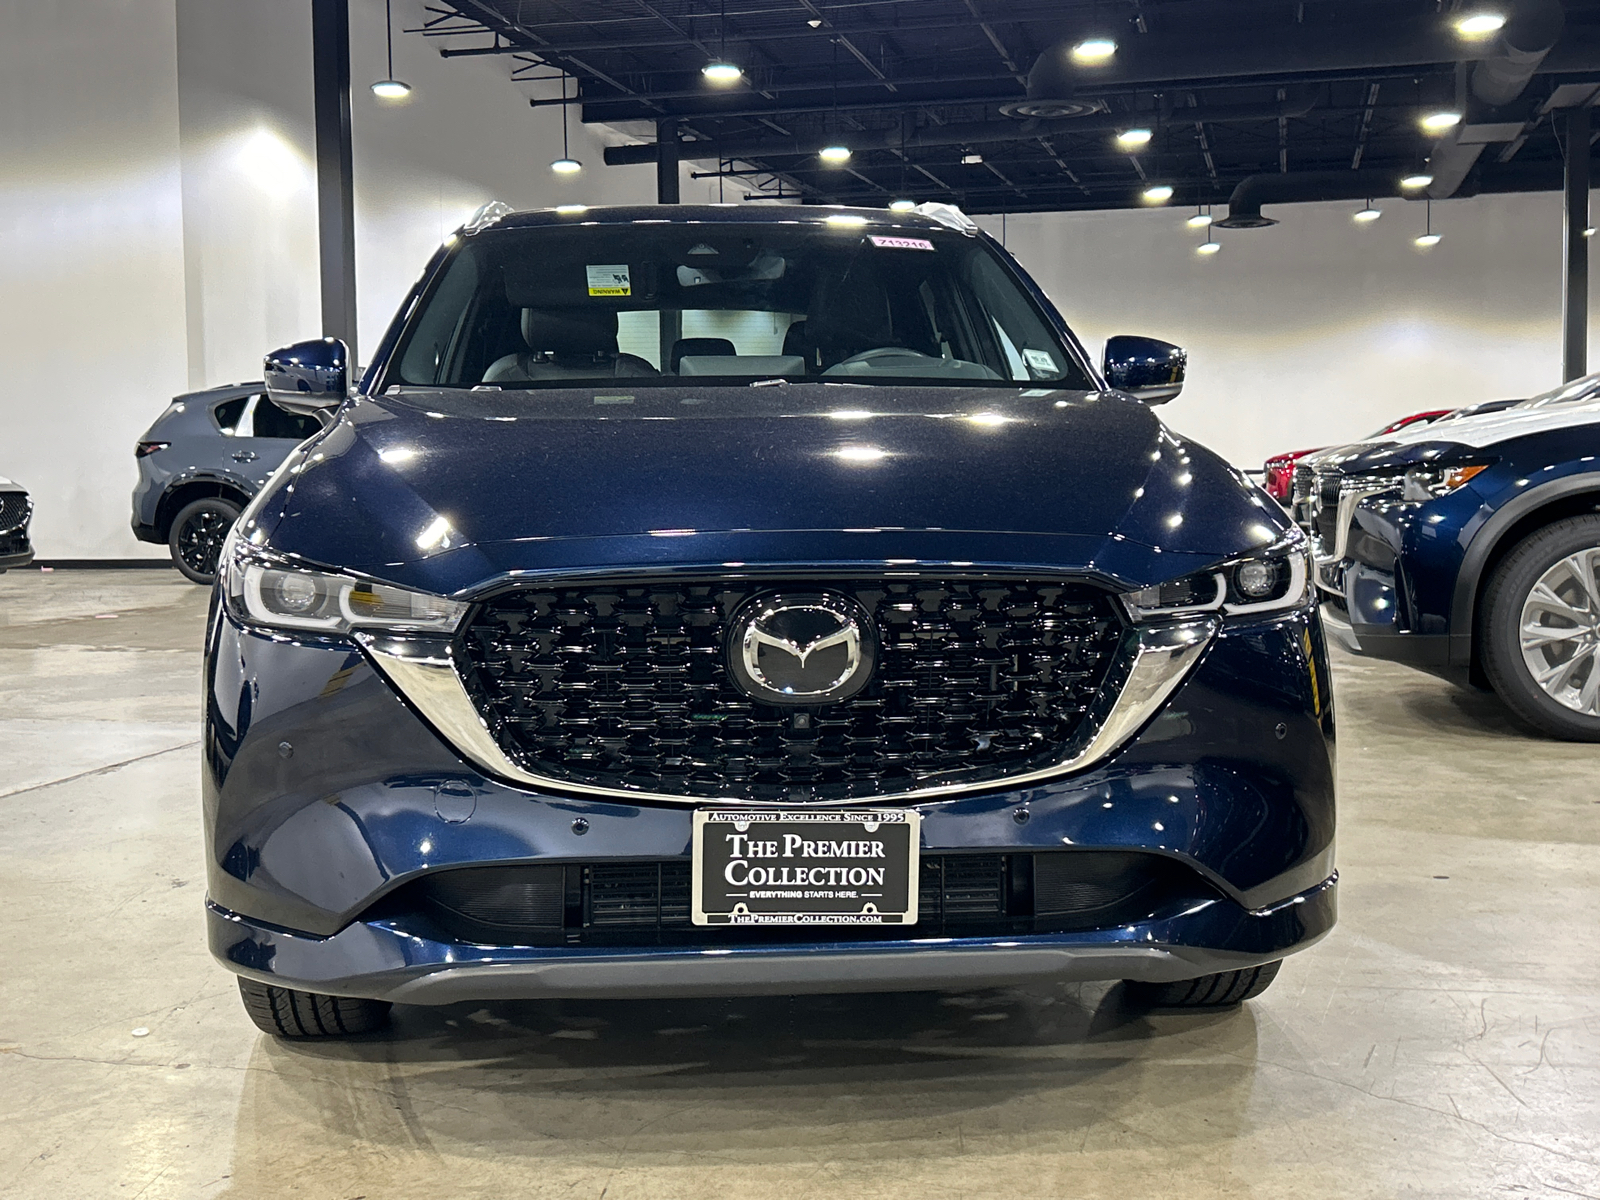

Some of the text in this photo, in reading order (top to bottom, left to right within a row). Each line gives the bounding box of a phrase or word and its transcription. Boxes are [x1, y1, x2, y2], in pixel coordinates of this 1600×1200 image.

[710, 812, 905, 822] AUTOMOTIVE EXCELLENCE SINCE 1995
[725, 833, 886, 858] THE PREMIER
[724, 859, 886, 886] COLLECTION
[749, 890, 859, 899] EVERYTHING STARTS HERE.
